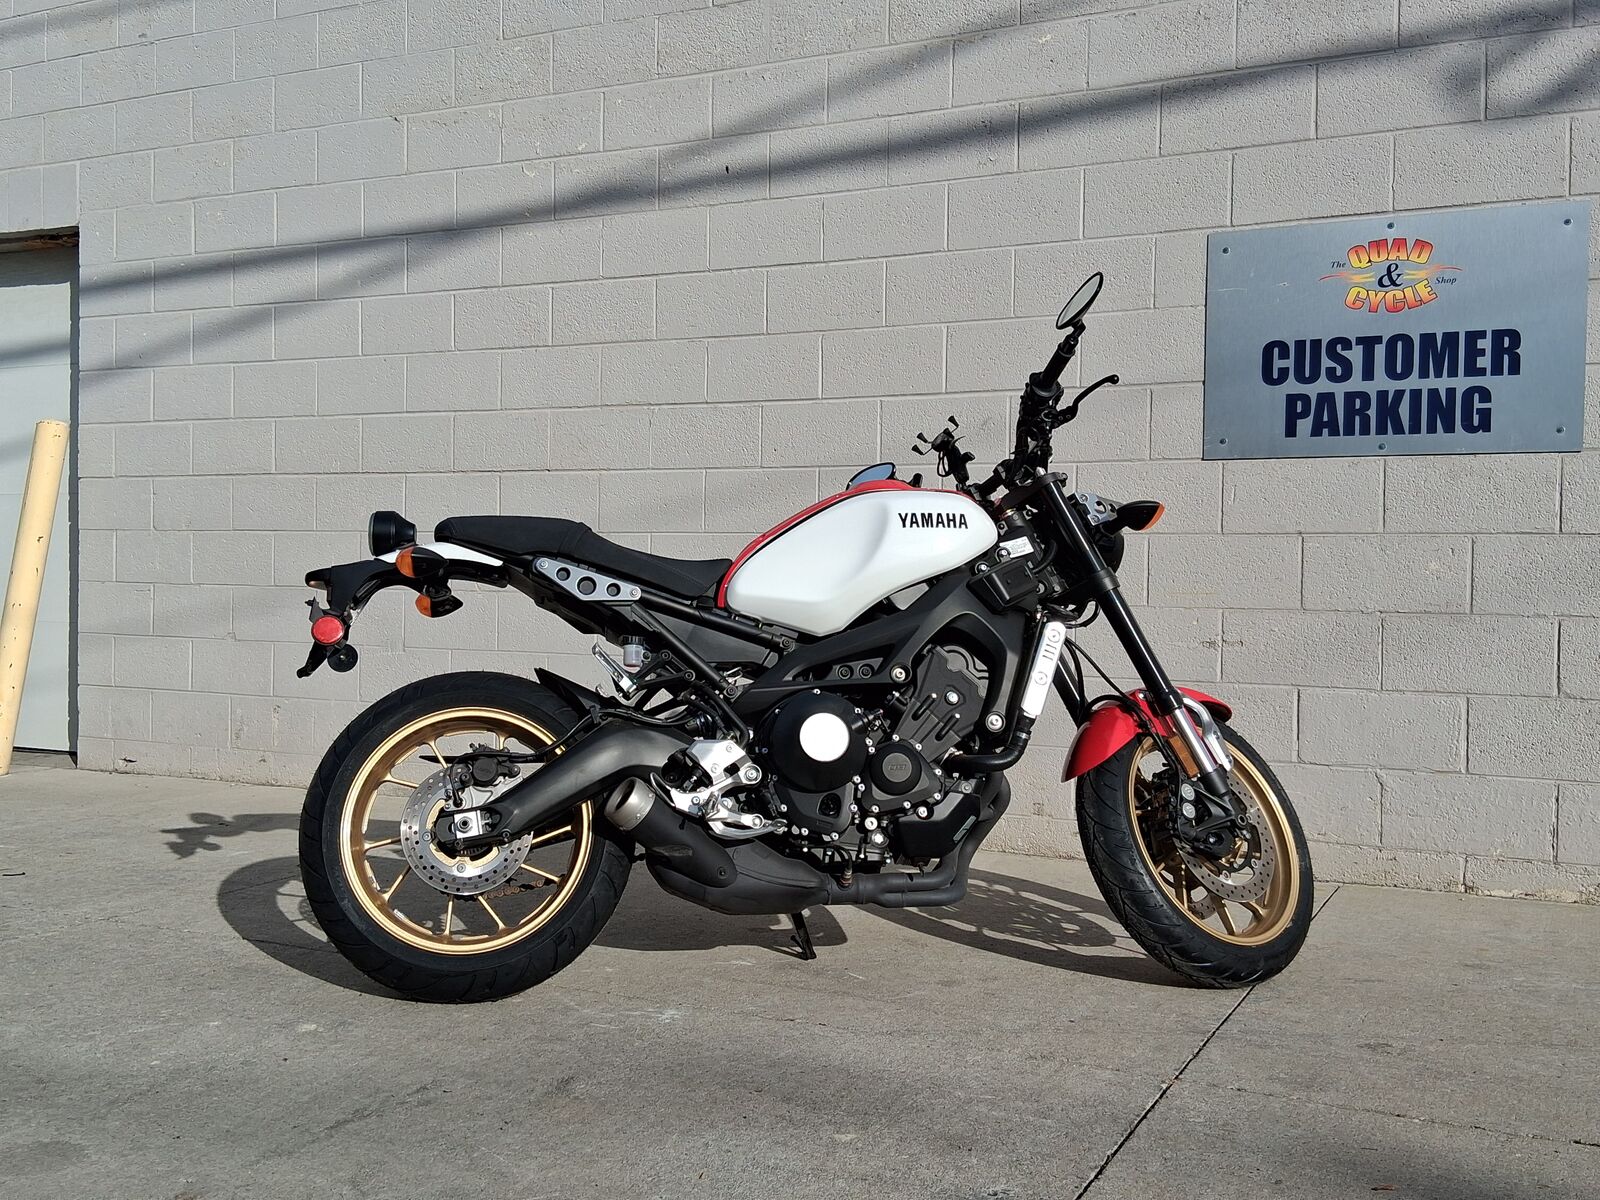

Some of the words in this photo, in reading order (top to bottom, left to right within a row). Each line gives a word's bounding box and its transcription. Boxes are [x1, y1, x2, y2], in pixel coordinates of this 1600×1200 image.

[1347, 238, 1433, 269] QUAD
[1377, 262, 1404, 288] &
[1435, 276, 1457, 285] Shop
[1344, 278, 1438, 313] CYCLE
[1261, 328, 1522, 386] CUSTOMER
[1284, 385, 1492, 438] PARKING
[898, 512, 968, 529] YAMAHA
